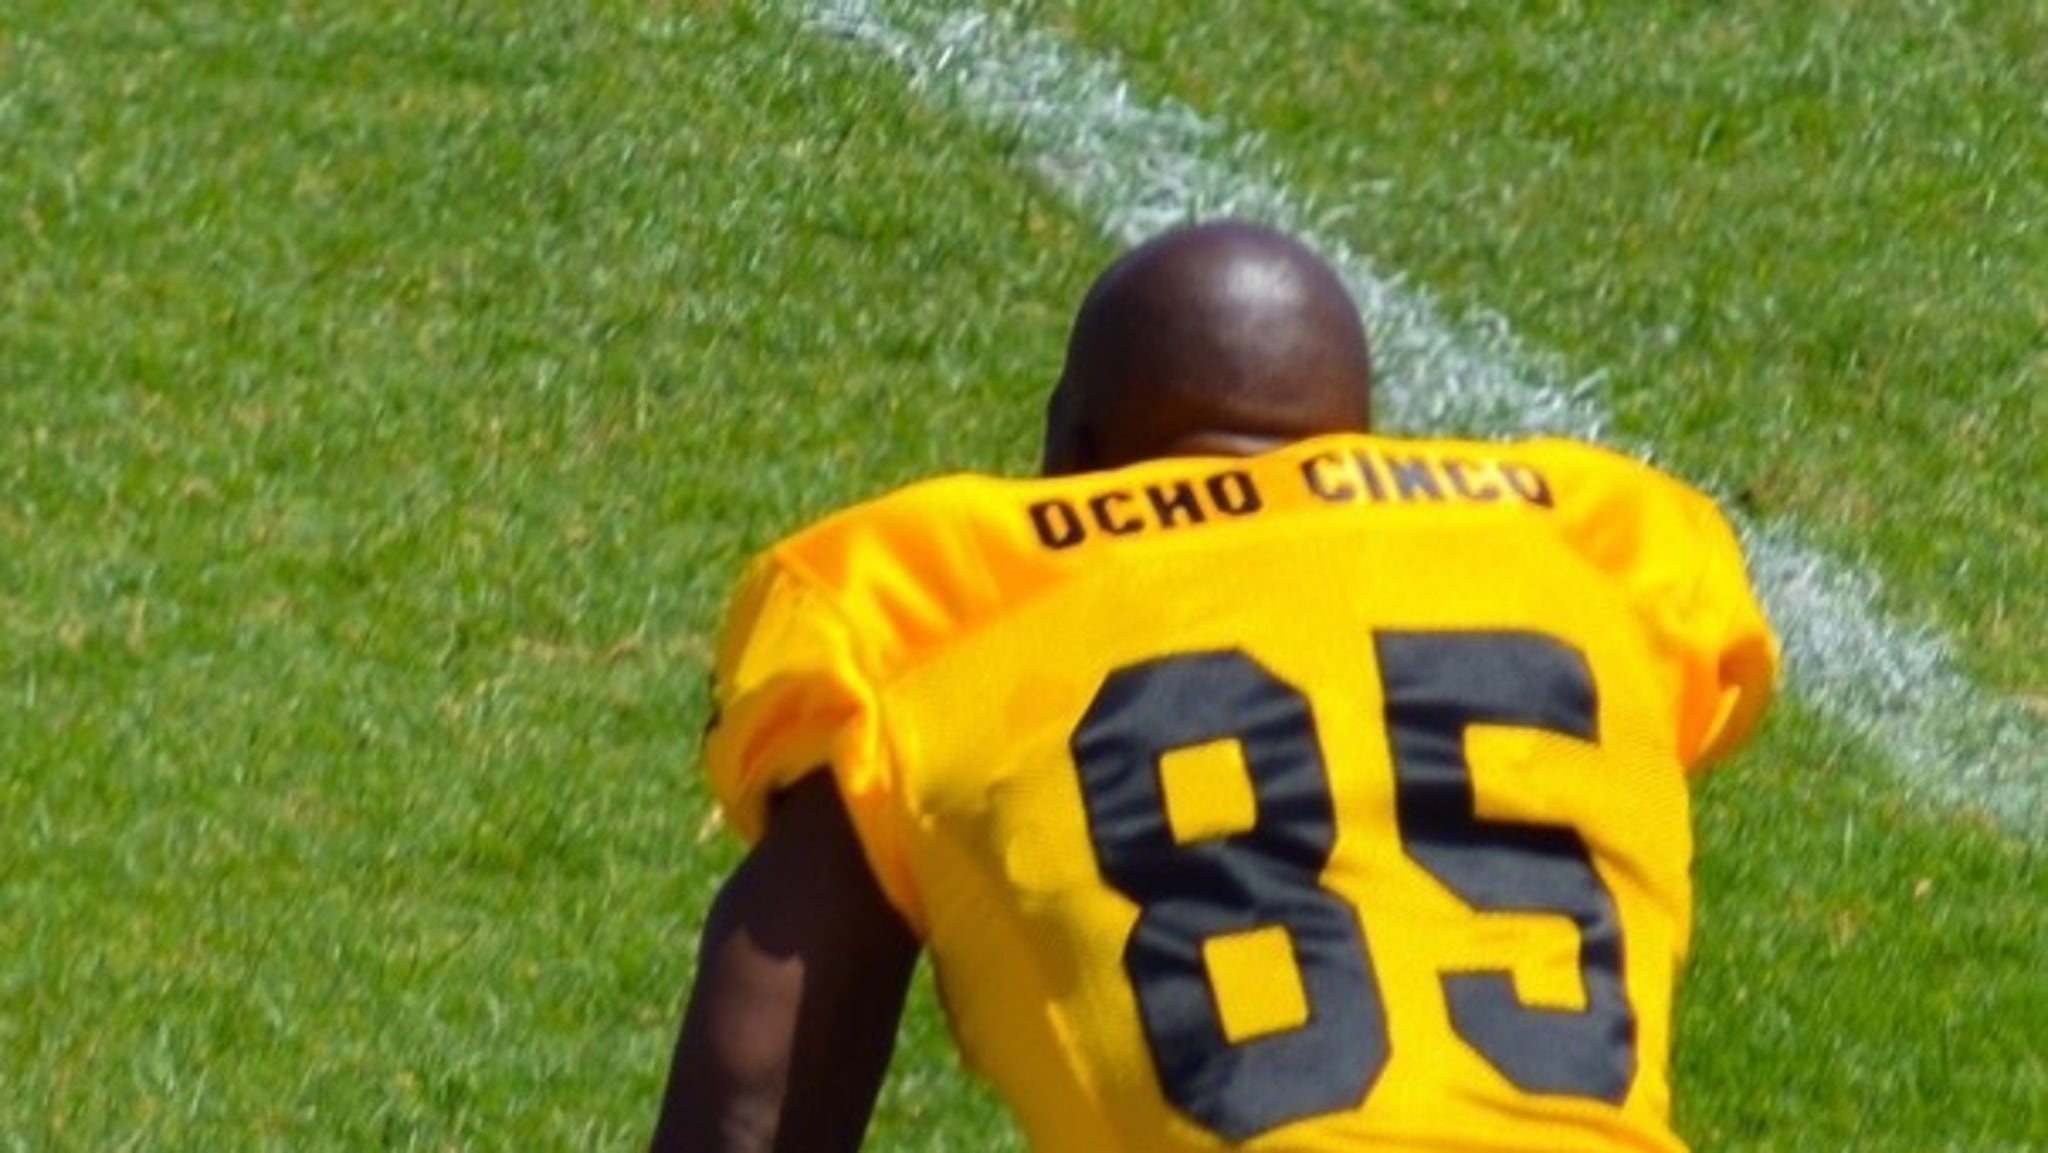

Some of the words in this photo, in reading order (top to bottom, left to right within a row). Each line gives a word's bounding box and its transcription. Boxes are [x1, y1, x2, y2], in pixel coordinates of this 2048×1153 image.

[1029, 470, 1262, 549] OCHO
[1301, 450, 1554, 508] CINCO
[1069, 627, 1639, 1143] 85
